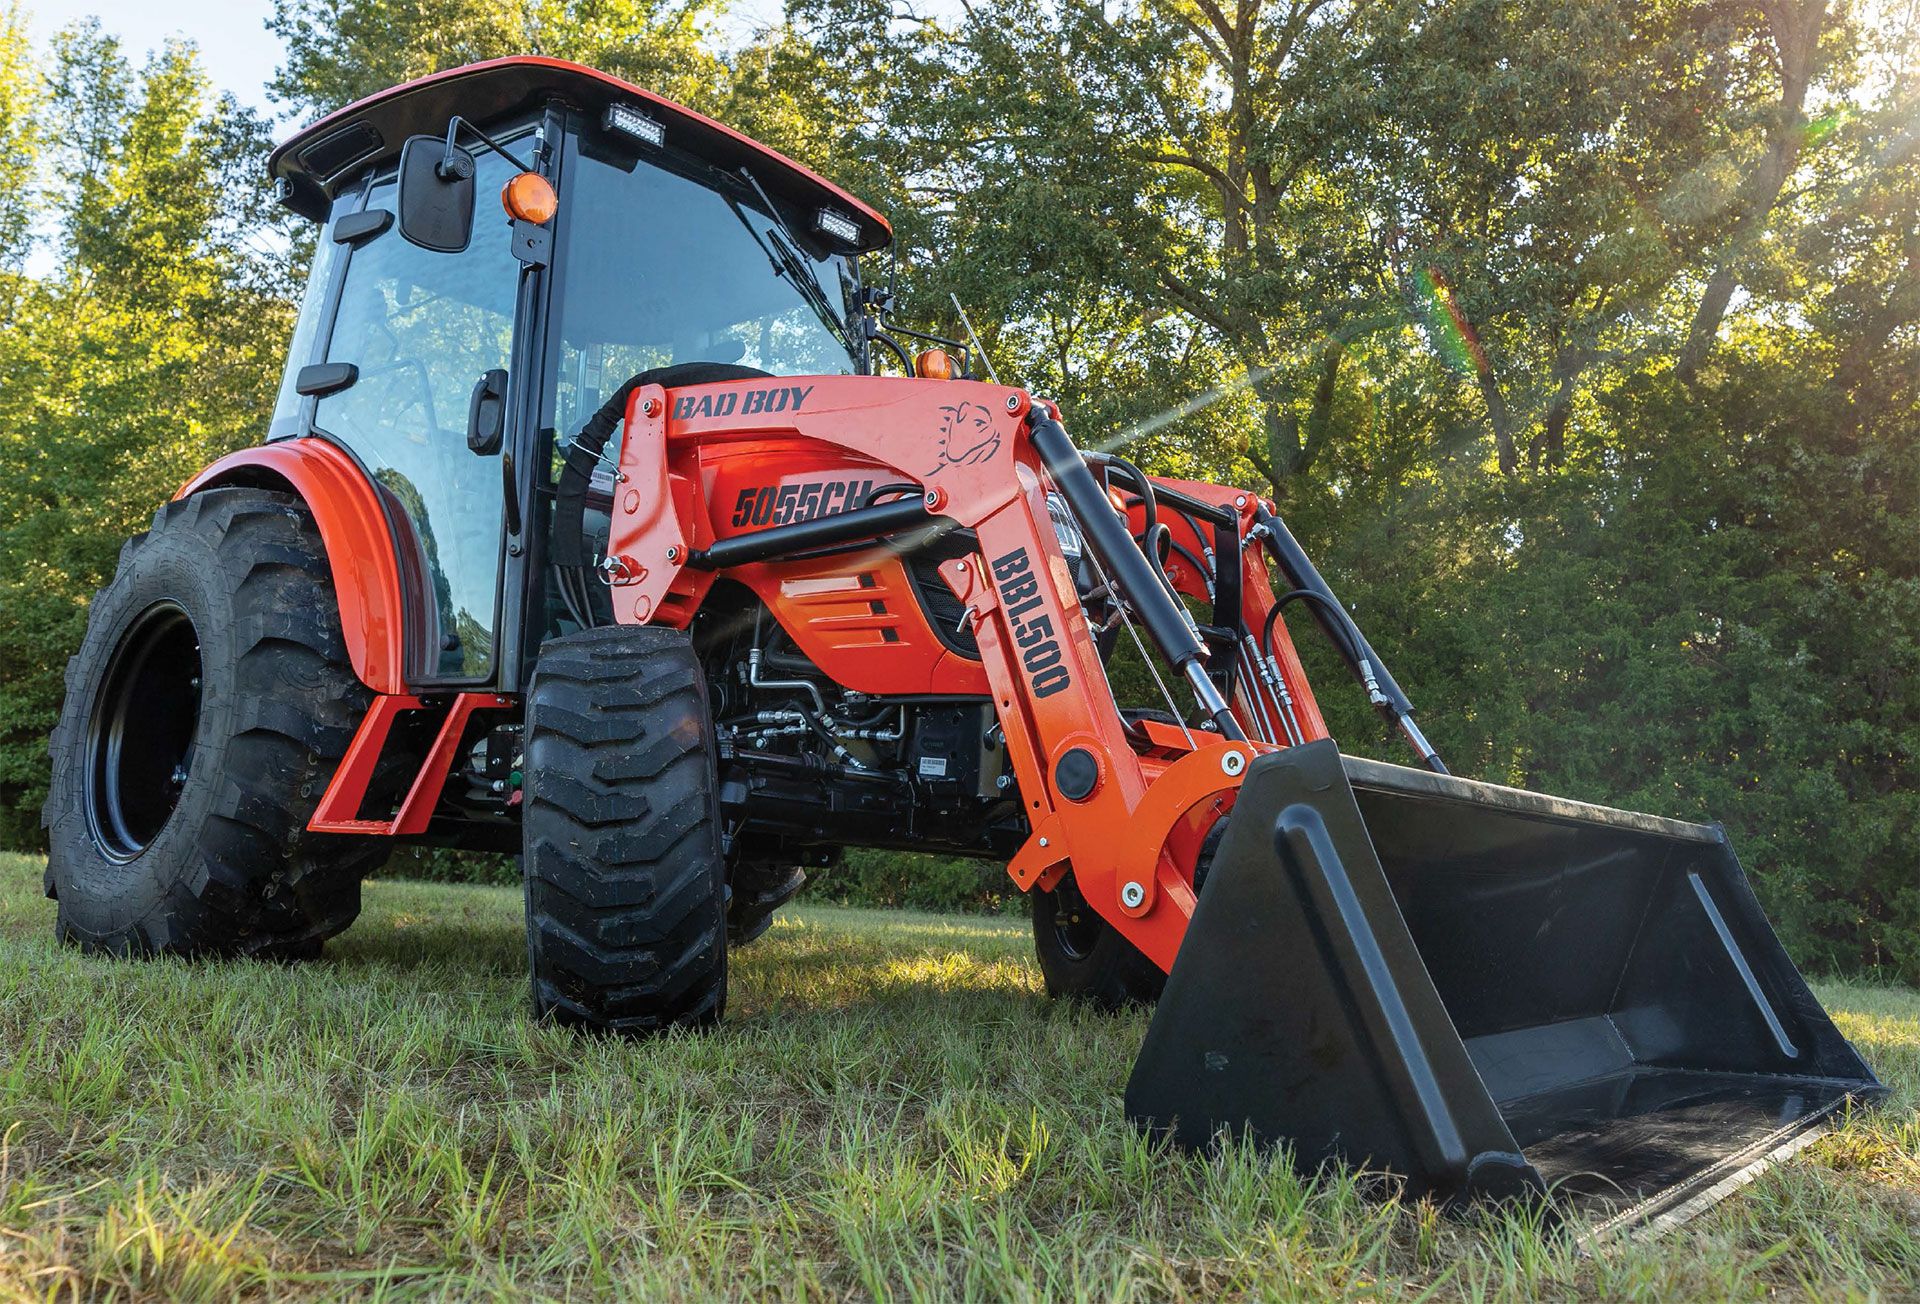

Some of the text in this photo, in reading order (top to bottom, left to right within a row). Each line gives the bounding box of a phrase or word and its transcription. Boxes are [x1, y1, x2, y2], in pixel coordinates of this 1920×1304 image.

[672, 386, 815, 420] BAD BOY
[992, 547, 1071, 699] BBL500
